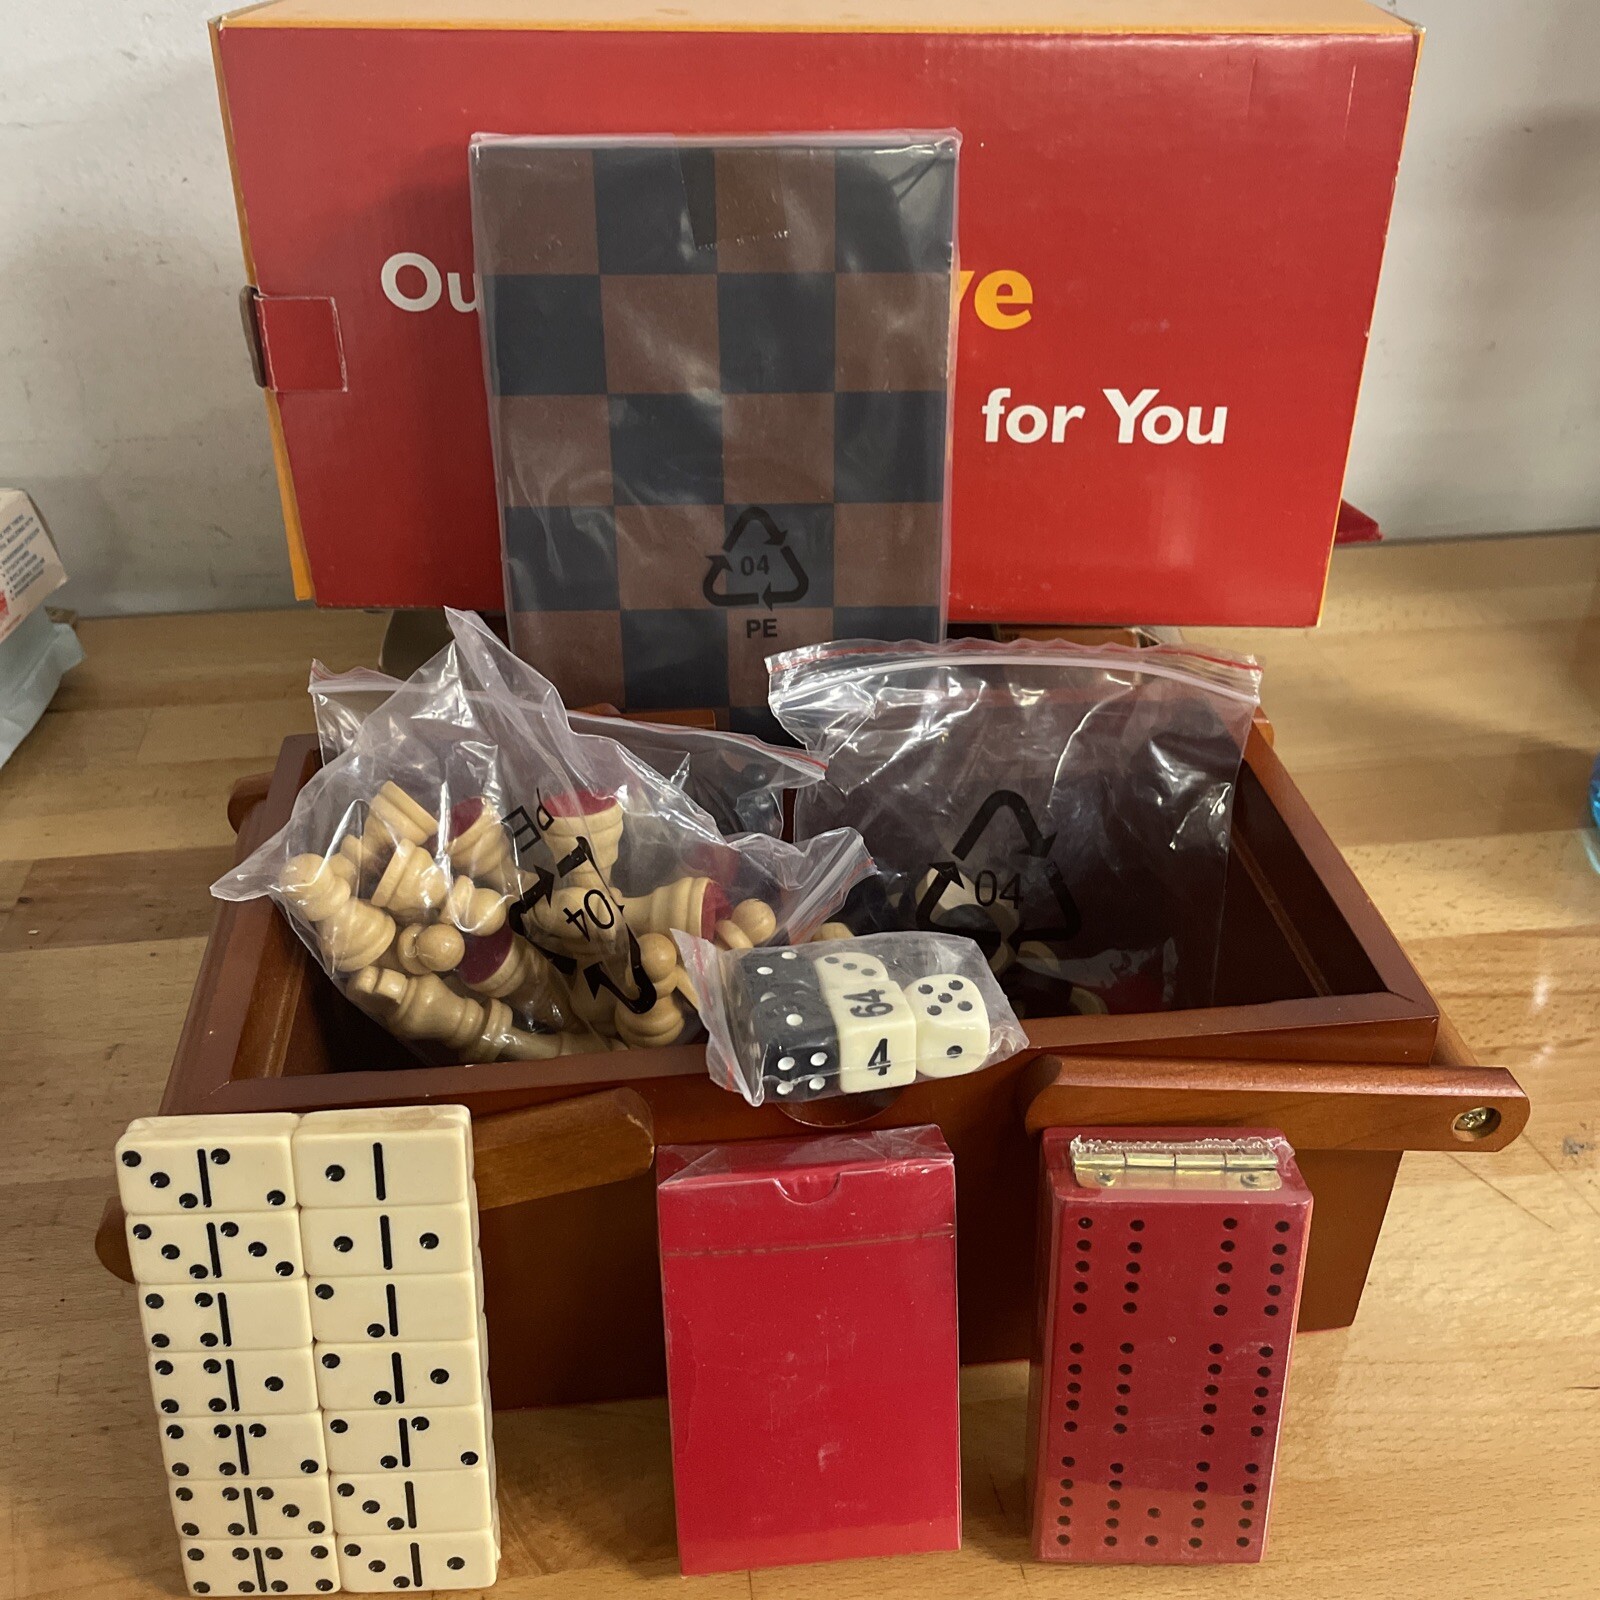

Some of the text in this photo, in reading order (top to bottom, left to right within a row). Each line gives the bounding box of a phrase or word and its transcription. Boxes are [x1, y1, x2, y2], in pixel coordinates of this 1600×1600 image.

[981, 387, 1228, 445] for You
[740, 554, 770, 577] 04
[746, 618, 778, 639] PE
[974, 869, 1024, 910] 04
[562, 889, 615, 942] 04
[843, 988, 894, 1018] 64
[867, 1037, 892, 1077] 4
